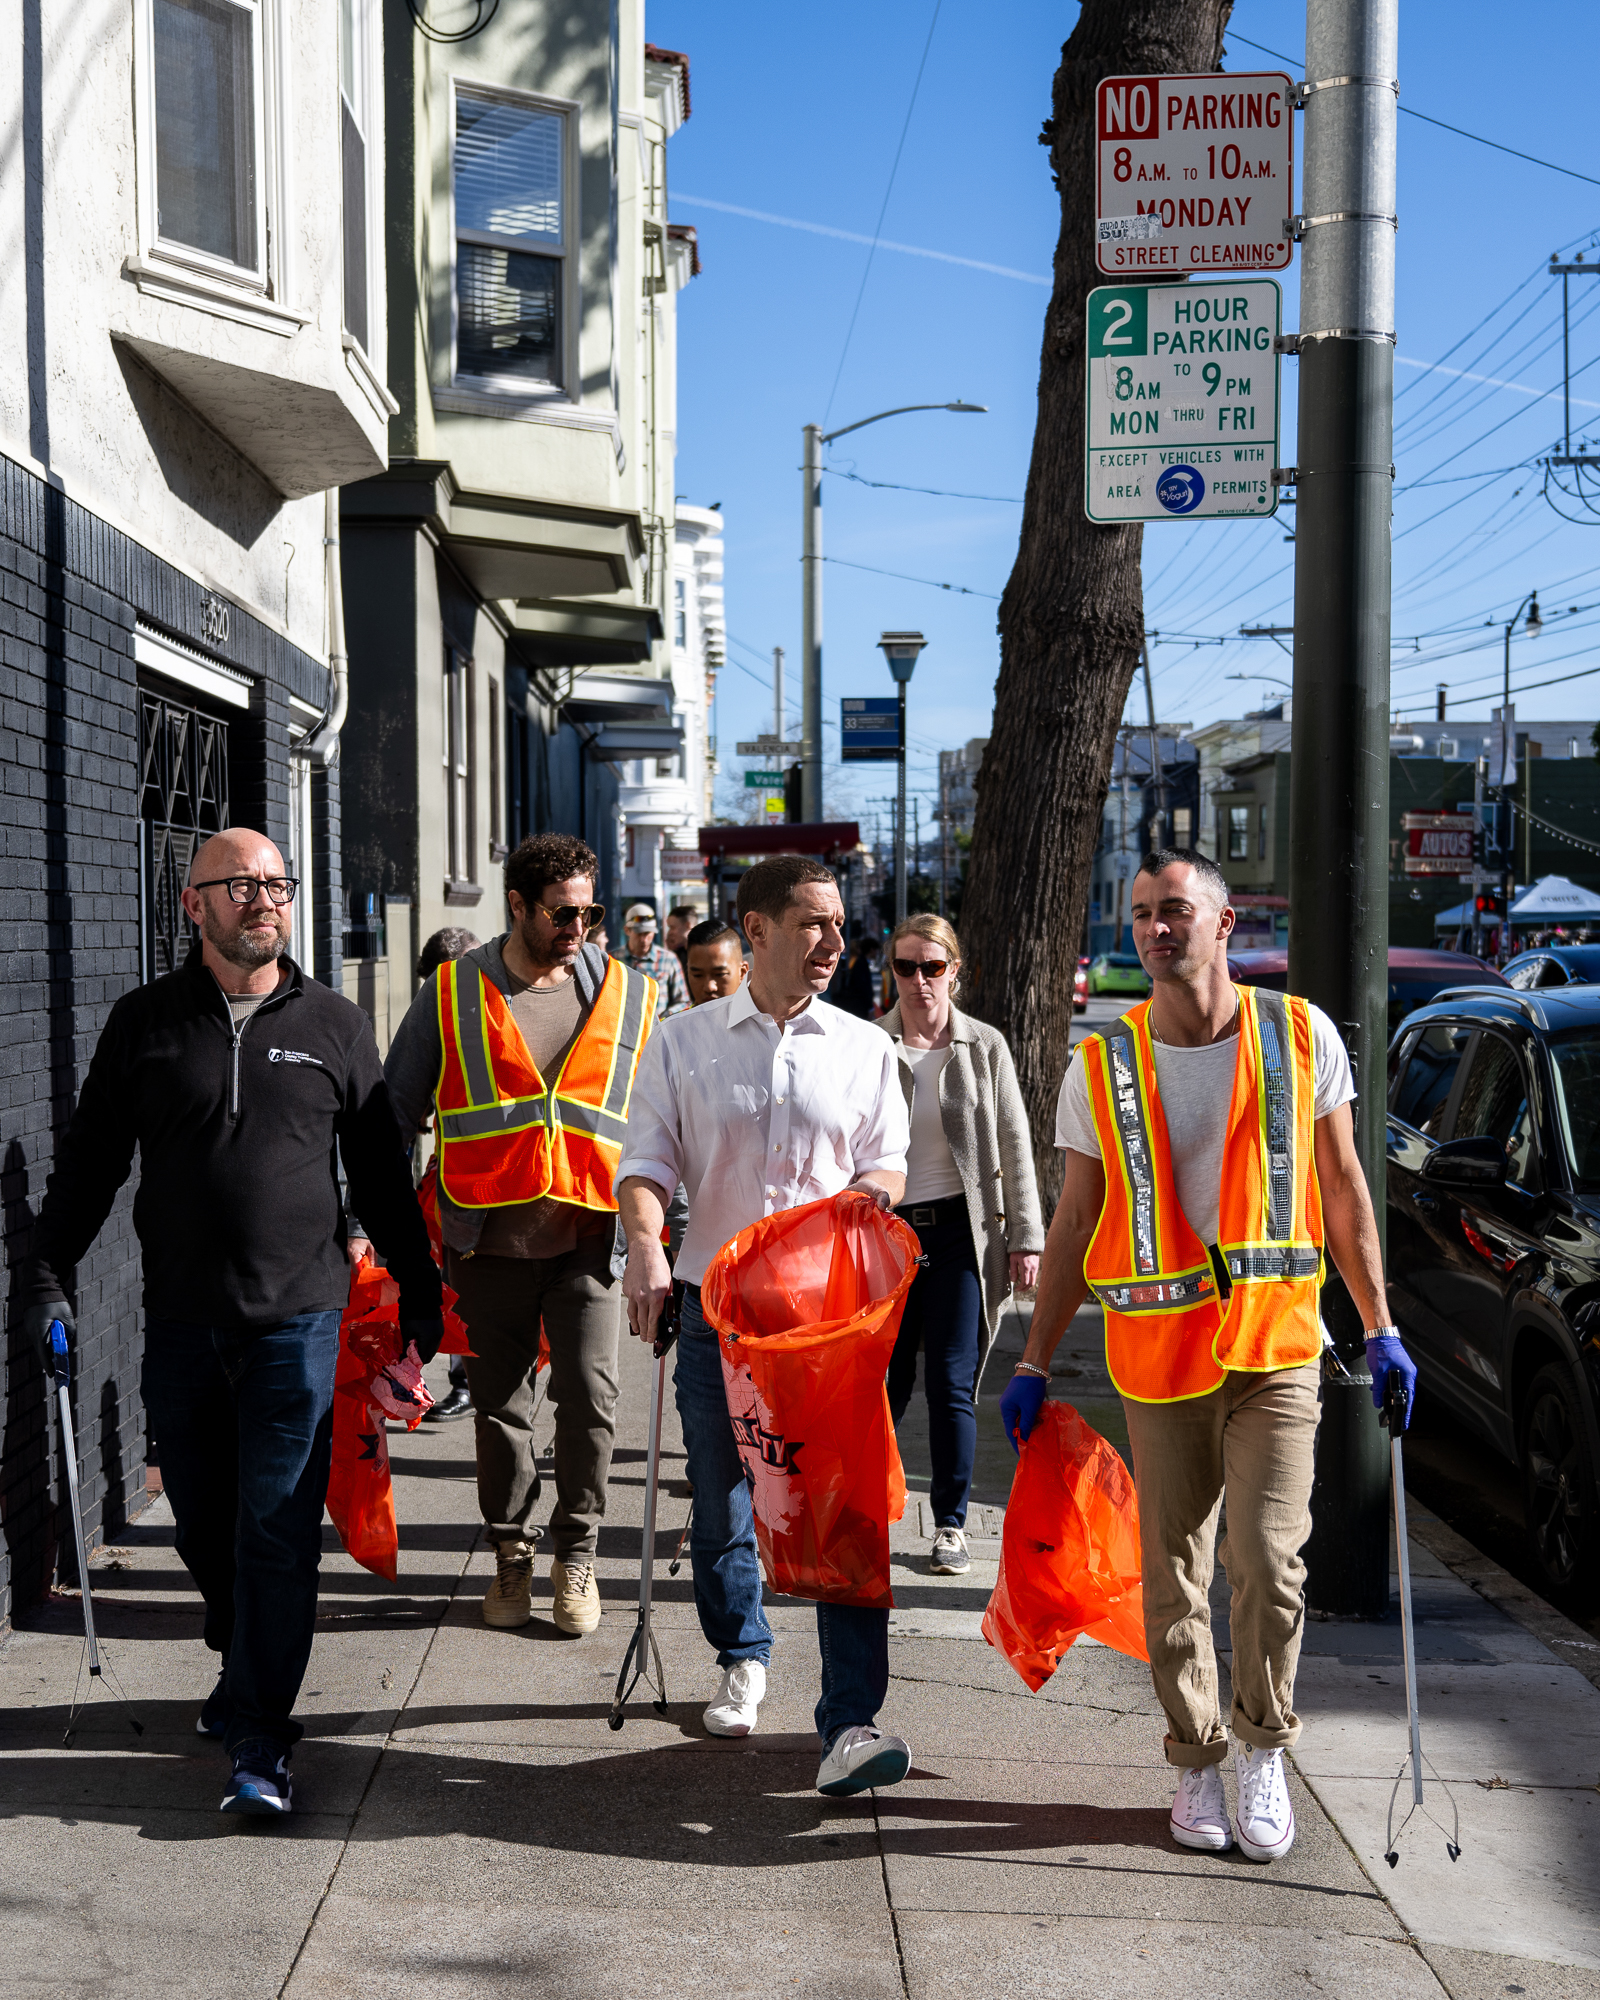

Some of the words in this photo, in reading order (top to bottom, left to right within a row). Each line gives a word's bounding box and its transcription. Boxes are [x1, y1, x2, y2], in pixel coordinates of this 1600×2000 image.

[1106, 84, 1151, 133] NO
[1167, 92, 1281, 131] PARKING
[1183, 167, 1198, 181] TO
[1115, 246, 1179, 266] STREET
[1190, 243, 1275, 264] CLEANING
[1102, 299, 1133, 346] 2
[1174, 297, 1249, 324] HOUR
[1153, 326, 1270, 356] PARKING
[1173, 363, 1191, 377] TO
[1110, 410, 1159, 435] MON
[1173, 409, 1205, 422] THRU
[1218, 406, 1255, 431] FRI
[1100, 453, 1148, 467] EXCEPT
[1159, 450, 1222, 465] VEHICLES
[1233, 448, 1265, 462] WITH
[1107, 485, 1142, 498] AREA
[1213, 480, 1267, 495] PERMITS
[844, 717, 857, 729] 33
[744, 745, 790, 754] VALENCIA
[1420, 831, 1471, 856] AUTOS
[751, 1424, 785, 1464] CTY
